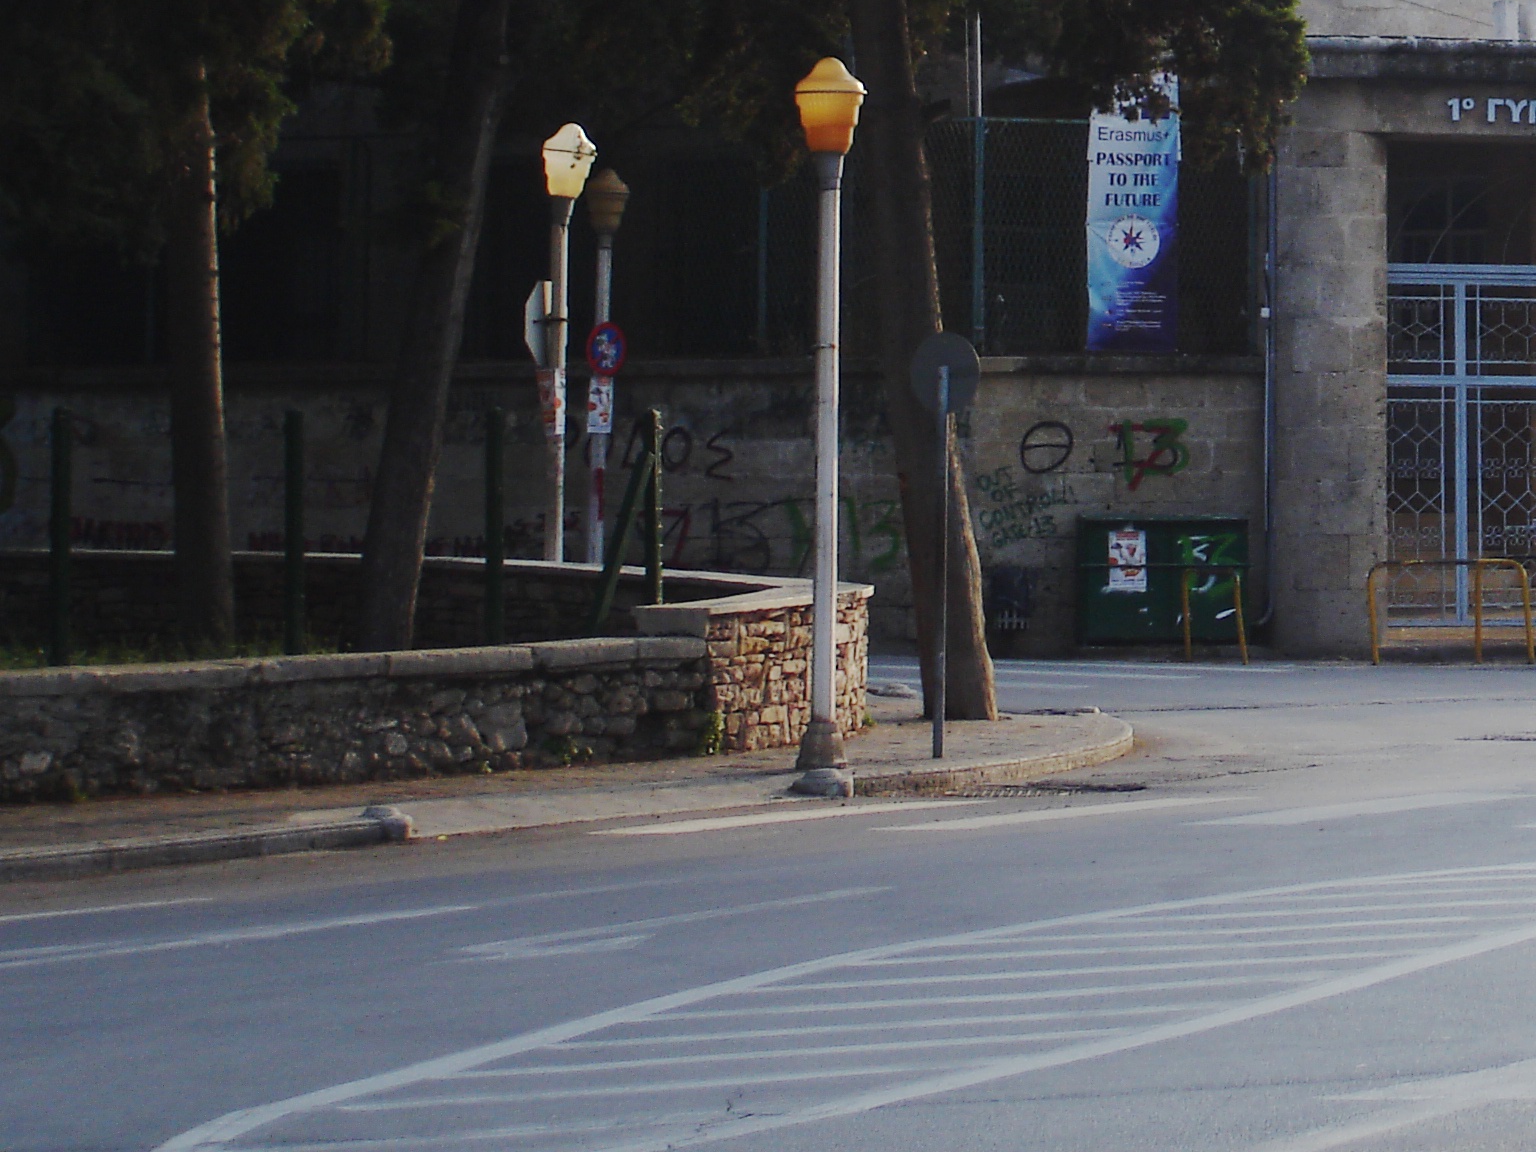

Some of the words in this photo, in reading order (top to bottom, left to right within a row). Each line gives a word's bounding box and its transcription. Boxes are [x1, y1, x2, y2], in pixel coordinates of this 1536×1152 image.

[1097, 126, 1170, 142] Erasmus+
[1096, 151, 1171, 167] PASSPORT
[1108, 172, 1127, 187] TO
[1133, 172, 1158, 187] THE
[1105, 192, 1161, 208] FUTURE
